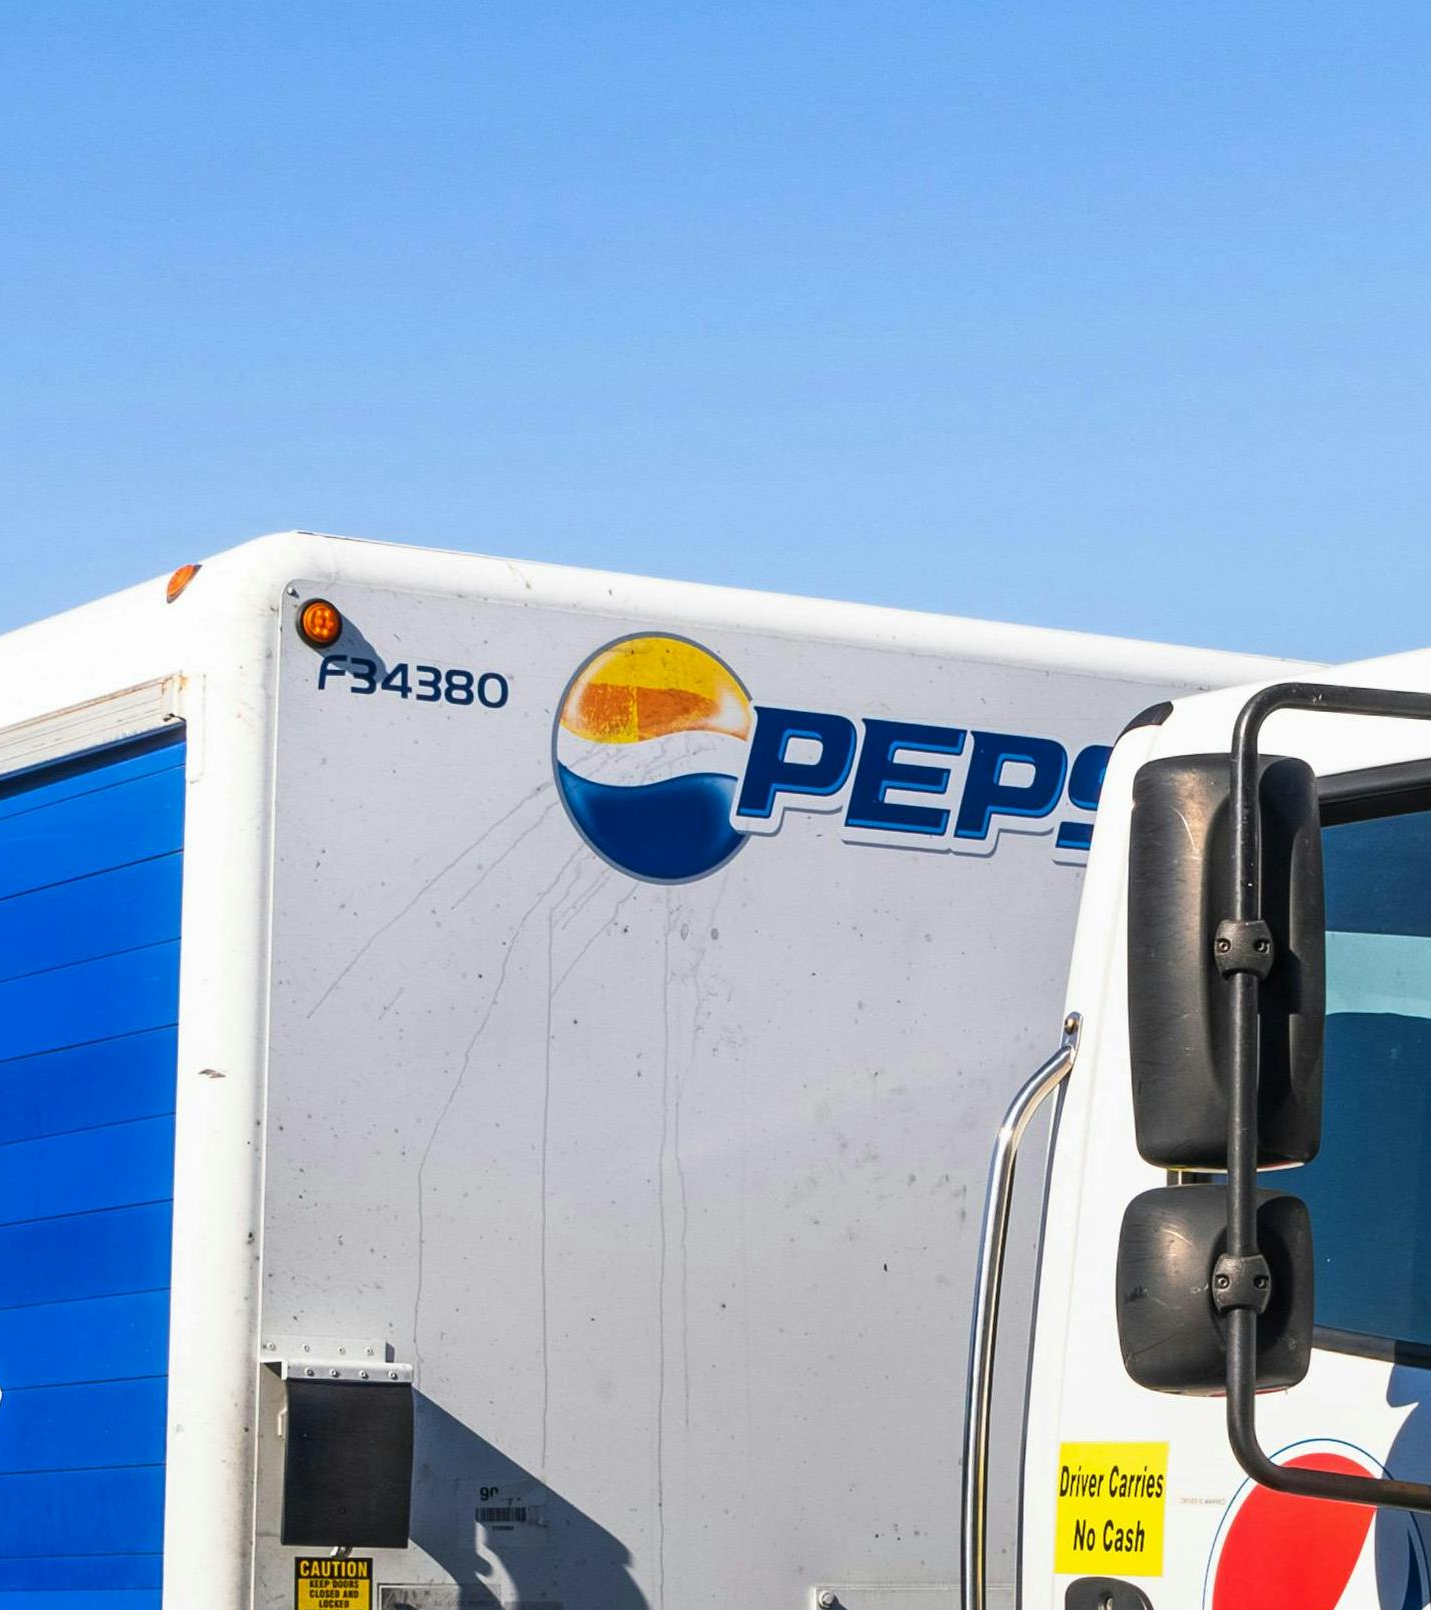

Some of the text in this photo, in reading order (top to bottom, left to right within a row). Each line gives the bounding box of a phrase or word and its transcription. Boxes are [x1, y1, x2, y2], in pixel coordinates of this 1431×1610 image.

[318, 654, 509, 710] F34380
[1059, 1464, 1165, 1499] Driver Carries
[1073, 1518, 1146, 1553] No Cash
[299, 1560, 369, 1578] CAUTION
[309, 1580, 360, 1589] KEEP DOORS
[309, 1590, 360, 1599] CLOSED AND
[318, 1600, 350, 1609] LOCKED
